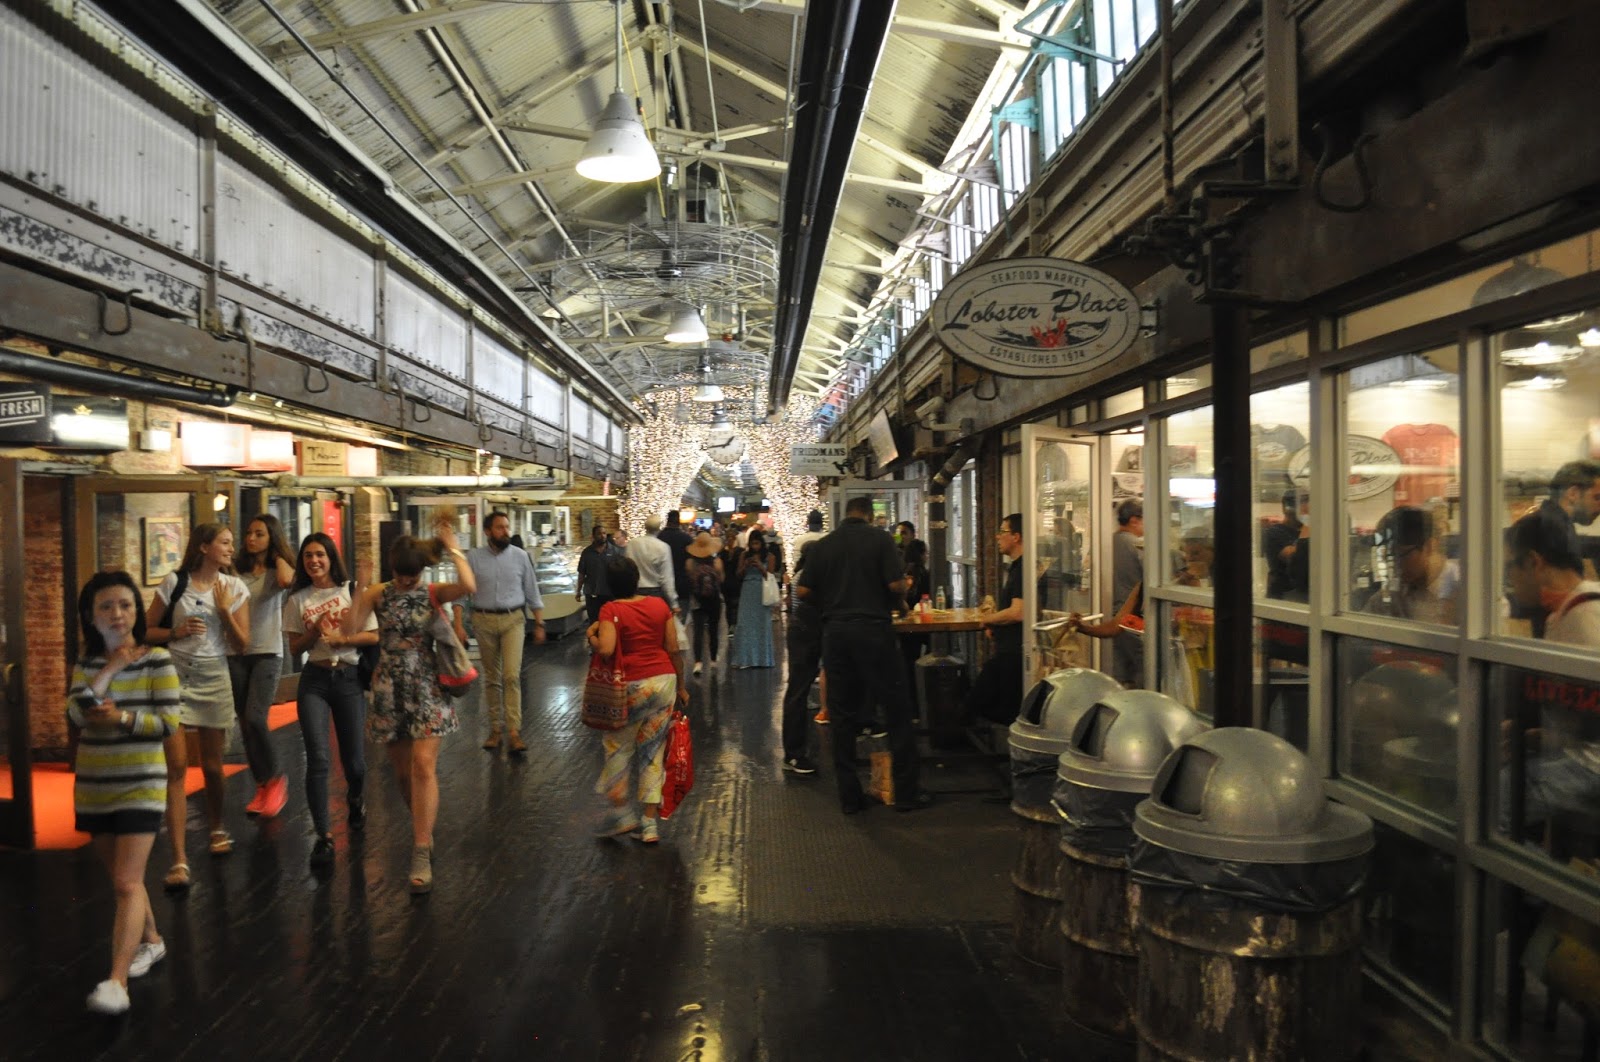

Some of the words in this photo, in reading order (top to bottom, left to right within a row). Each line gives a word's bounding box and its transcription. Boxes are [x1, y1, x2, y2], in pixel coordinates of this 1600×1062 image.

[991, 270, 1040, 284] SEAFOOD
[1045, 271, 1088, 287] MARKET
[941, 299, 1041, 331] Lobster
[1050, 288, 1129, 321] Place
[989, 345, 1058, 364] ESTABLISHED
[1061, 349, 1085, 362] 1974
[0, 399, 40, 416] FRESH
[792, 447, 846, 456] FRIEDMANS
[302, 596, 340, 622] cherry
